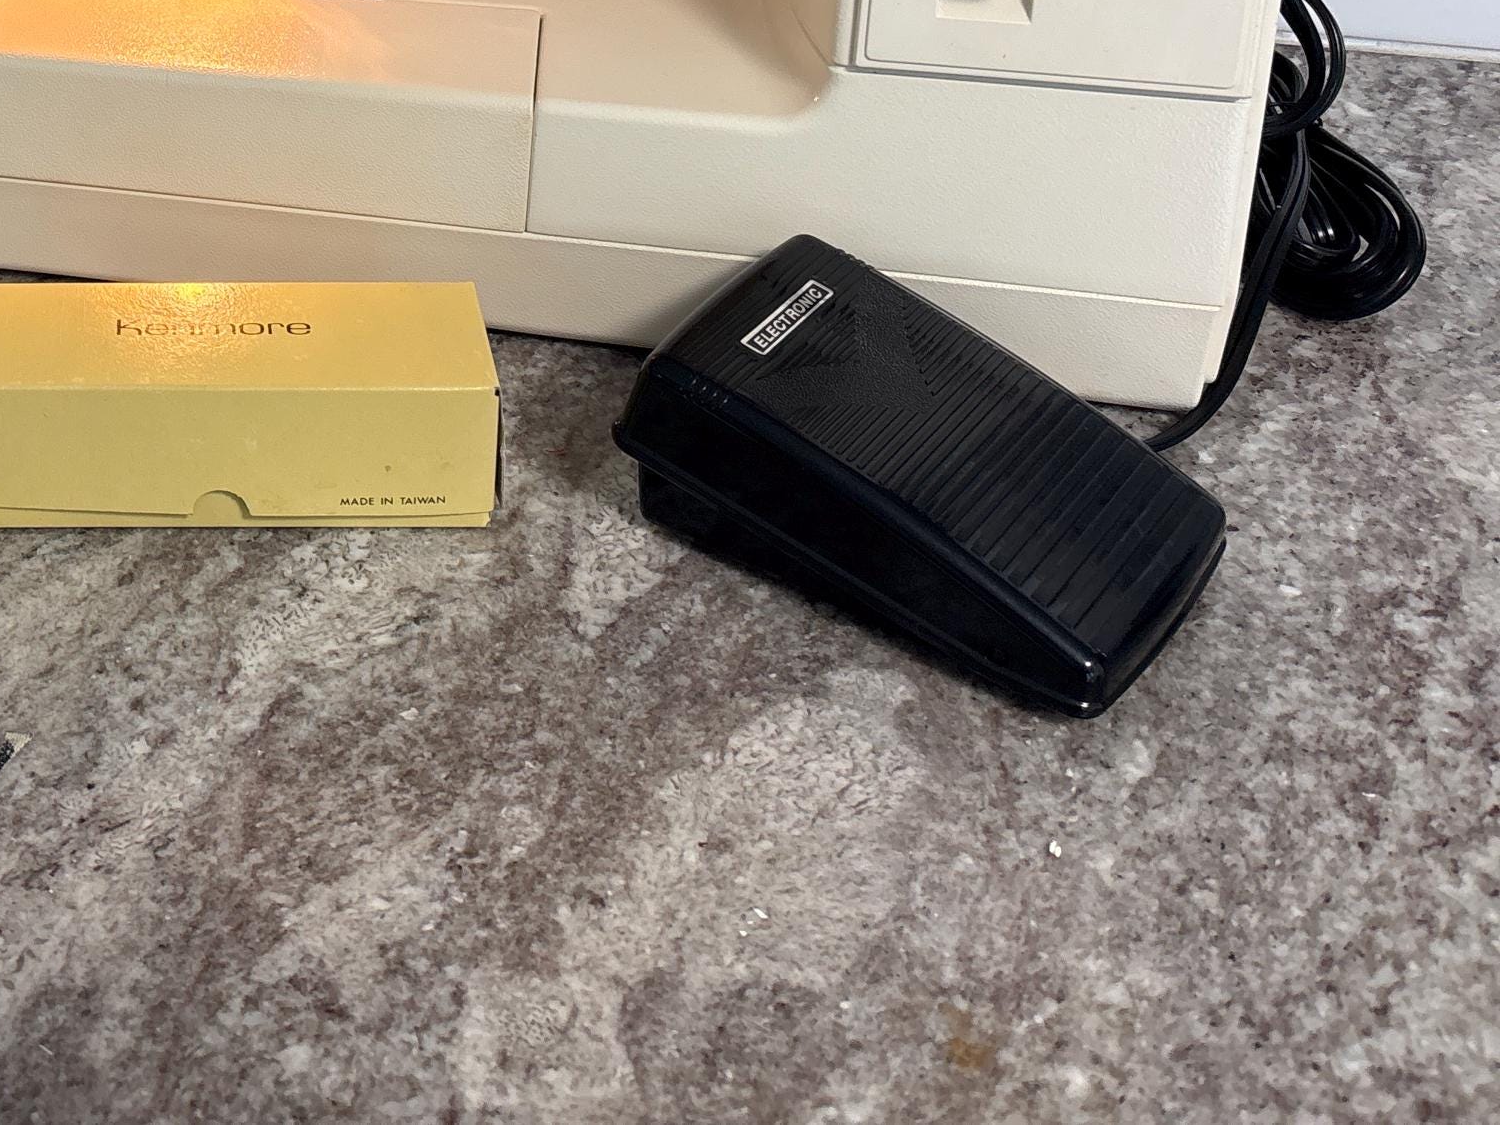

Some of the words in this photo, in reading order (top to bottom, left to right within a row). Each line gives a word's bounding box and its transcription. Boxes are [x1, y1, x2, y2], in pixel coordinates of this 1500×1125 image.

[116, 318, 311, 336] Kenmore
[753, 287, 823, 349] ELECTRONIC
[340, 496, 375, 507] MADE
[380, 496, 393, 506] IN
[400, 495, 446, 505] TAIWAN
